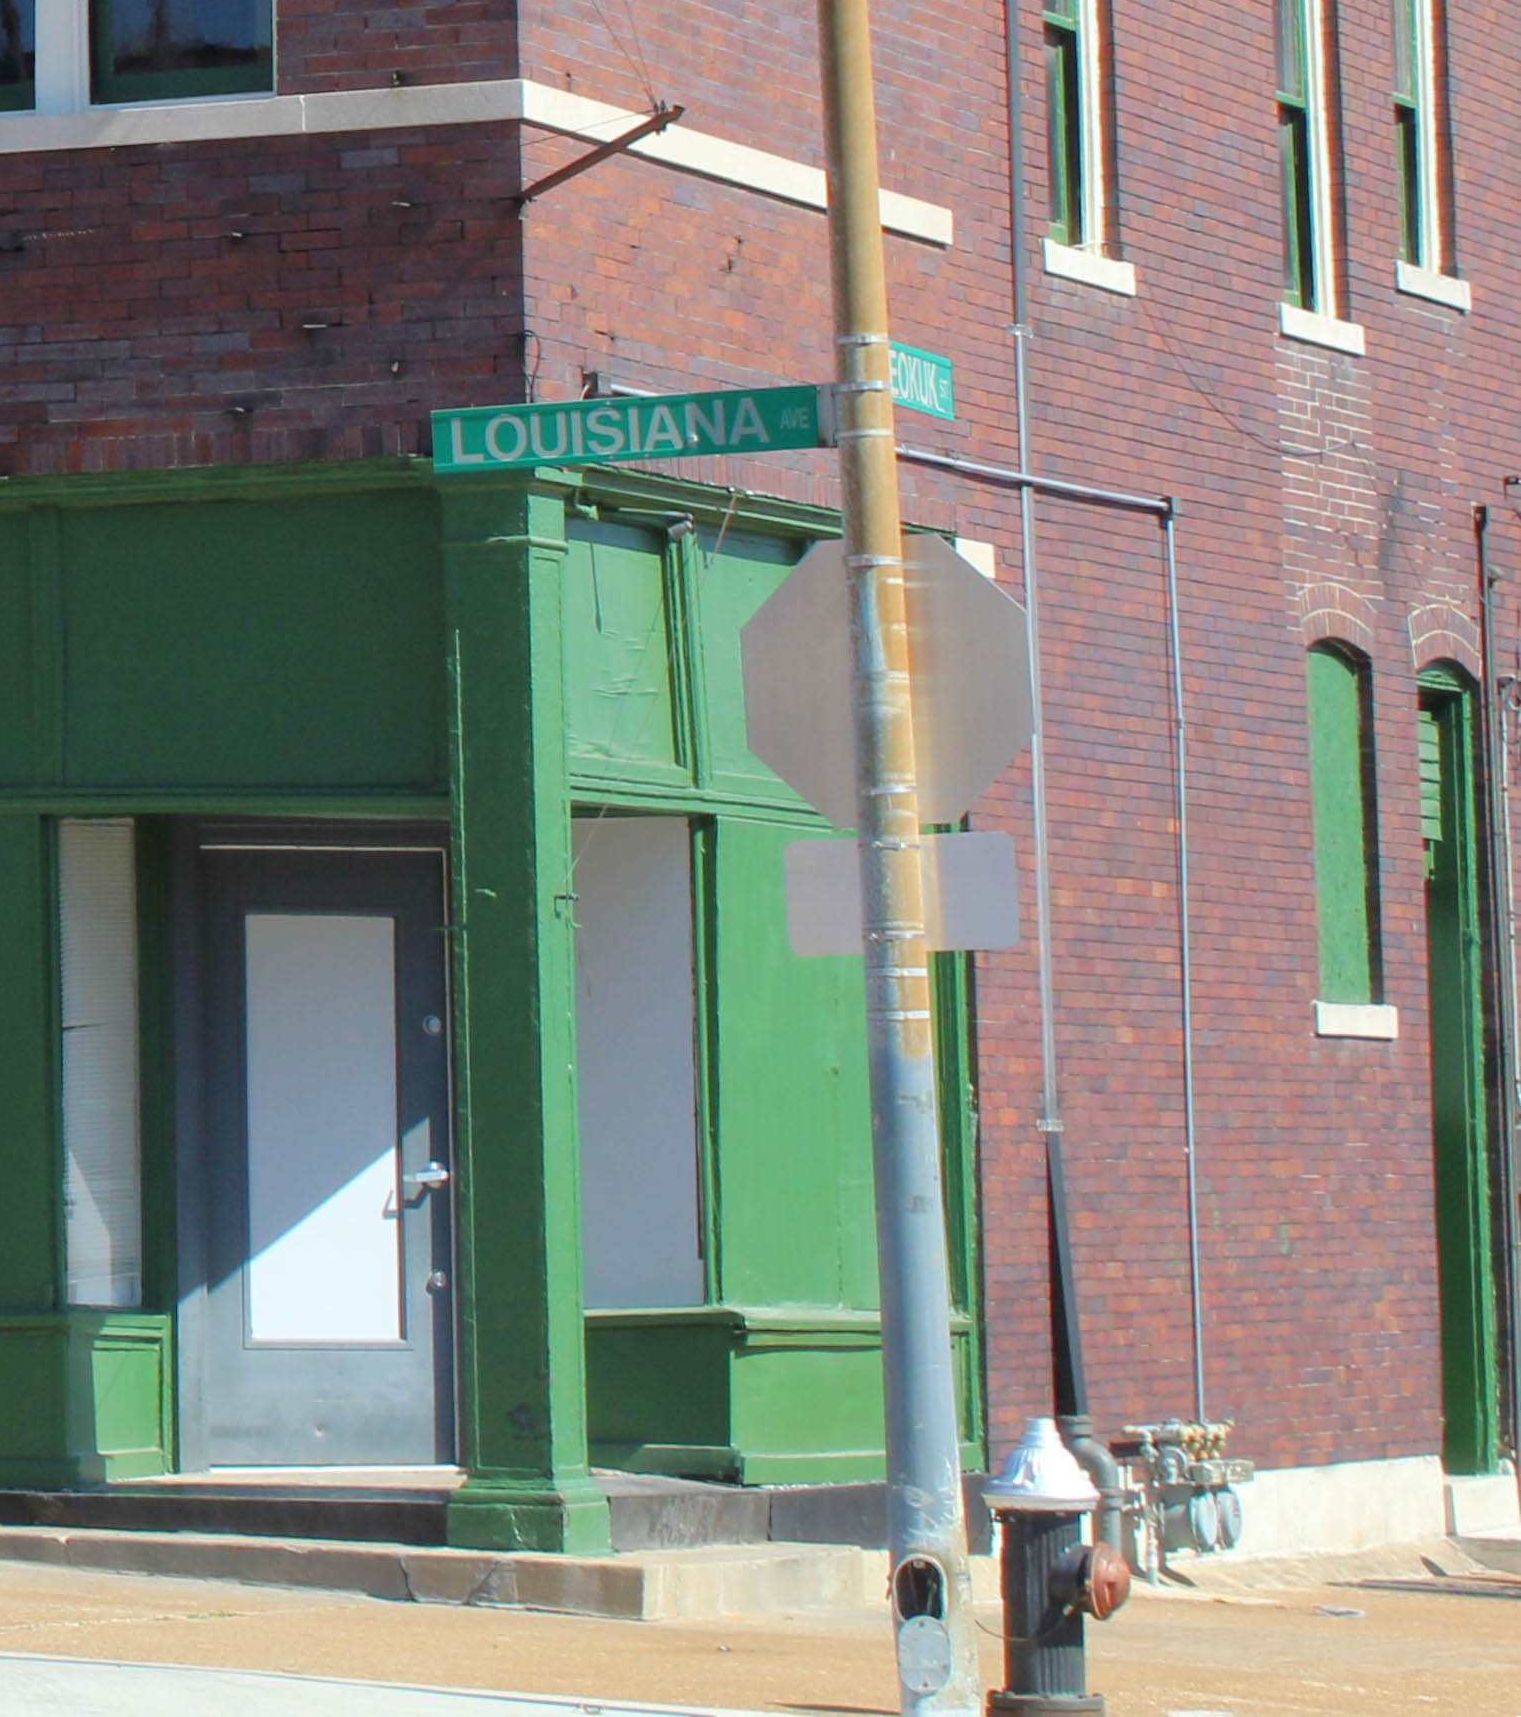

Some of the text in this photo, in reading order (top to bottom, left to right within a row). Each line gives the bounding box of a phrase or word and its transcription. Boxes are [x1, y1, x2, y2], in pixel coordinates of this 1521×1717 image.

[888, 350, 944, 411] EOKUK
[450, 397, 810, 464] LOUISIANA AVE
